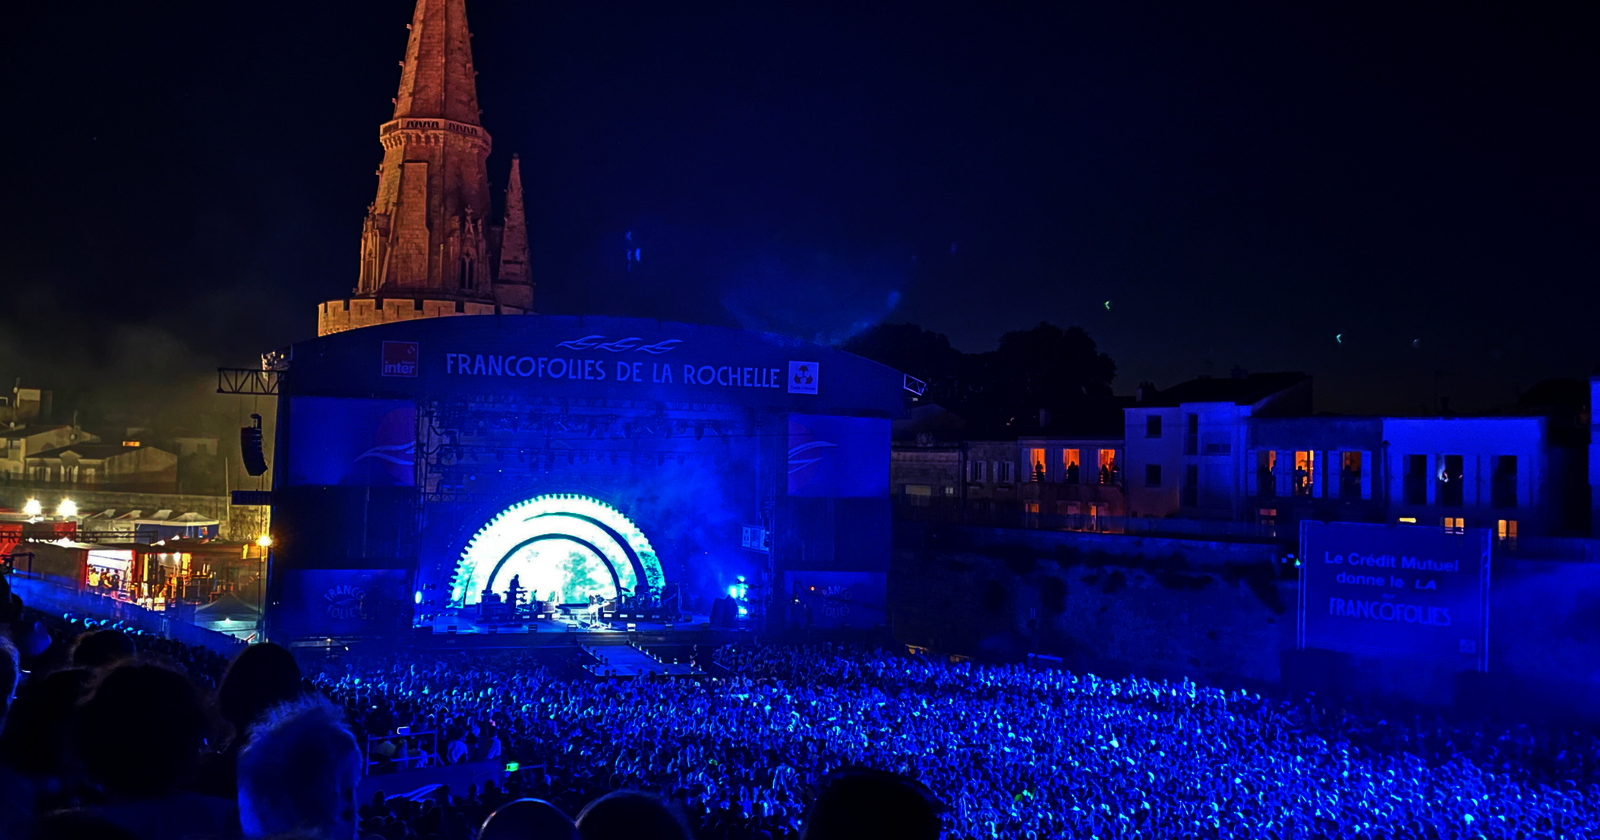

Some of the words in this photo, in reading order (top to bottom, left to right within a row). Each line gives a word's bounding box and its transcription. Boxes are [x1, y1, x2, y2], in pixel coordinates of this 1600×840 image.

[384, 360, 415, 374] inter
[446, 353, 606, 380] FRANCOFOLIES
[616, 361, 643, 382] DE
[652, 363, 673, 384] LA
[683, 364, 780, 388] ROCHELLE
[1325, 551, 1343, 565] Le
[1348, 552, 1396, 569] Crédit
[1401, 556, 1459, 573] Mutuel
[1336, 571, 1385, 587] donne
[1390, 575, 1404, 589] le
[1414, 579, 1437, 590] LA
[324, 585, 366, 601] FRANCO
[1329, 597, 1451, 627] FRANCOFOLIES
